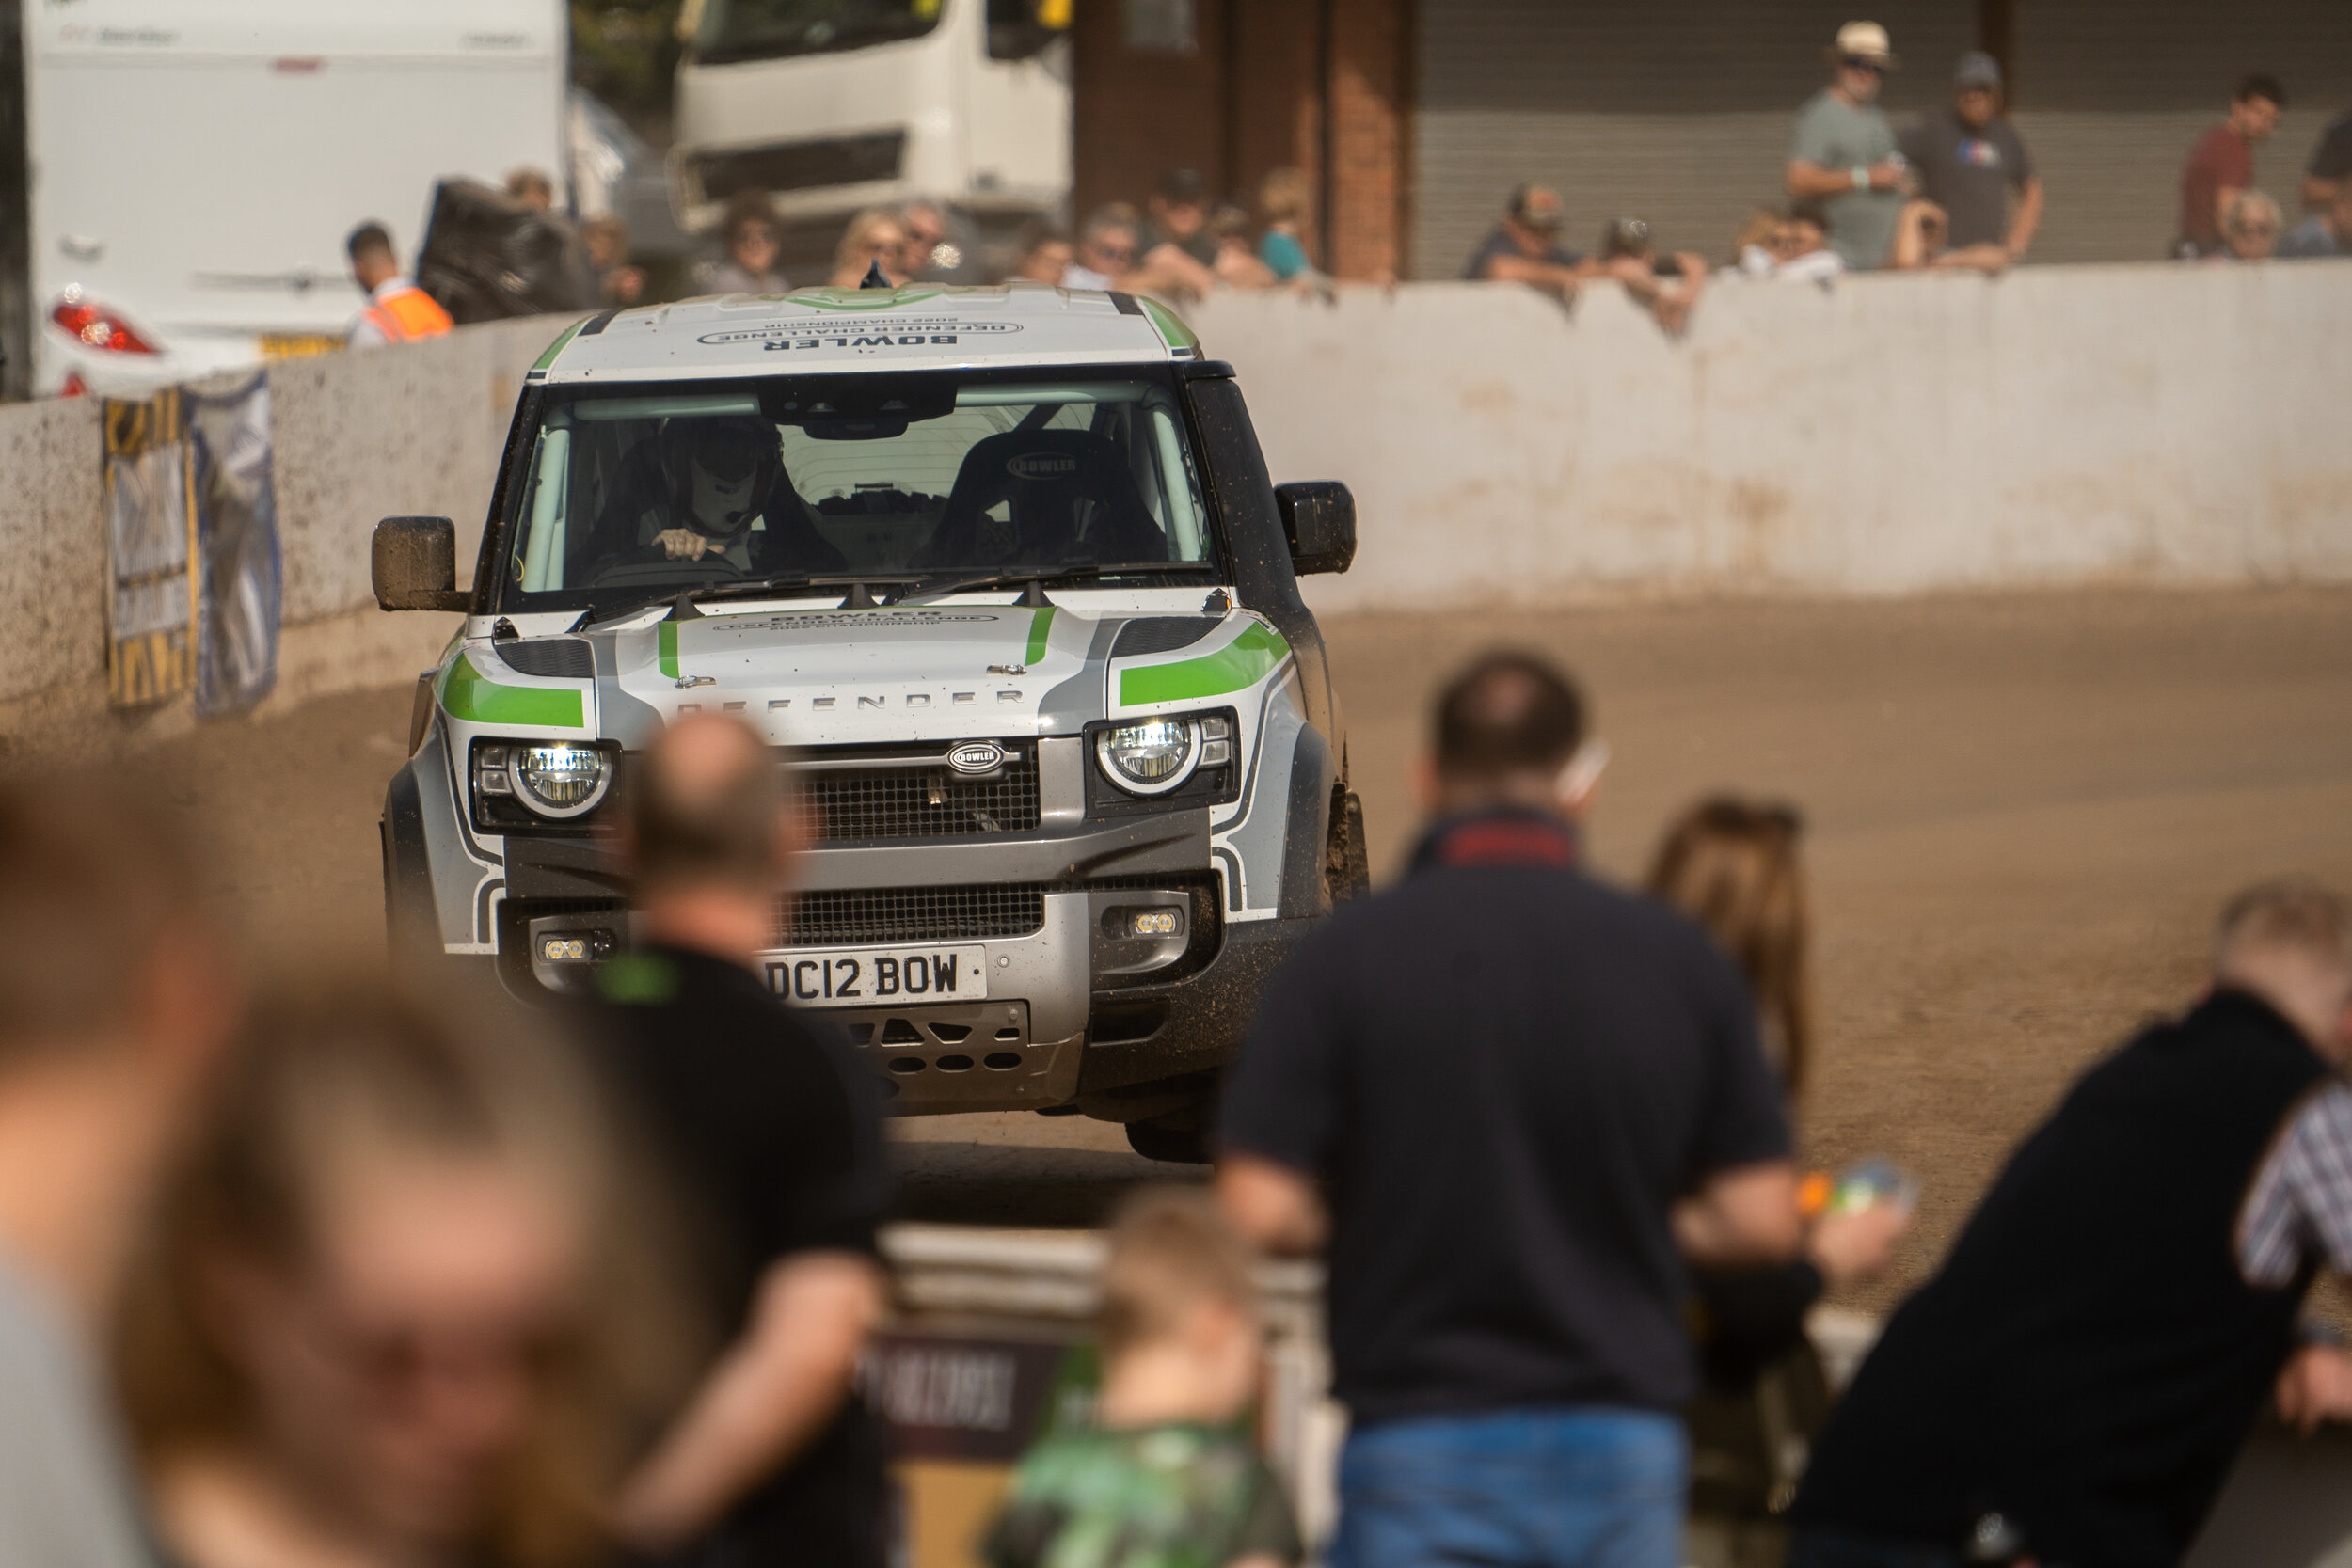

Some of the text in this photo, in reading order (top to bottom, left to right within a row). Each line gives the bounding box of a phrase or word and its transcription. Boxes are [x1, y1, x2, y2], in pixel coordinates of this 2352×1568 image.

[765, 319, 907, 329] CHAMPIONSHIP
[718, 325, 1006, 341] DEFENDER CHALLENGE
[764, 335, 958, 351] BOWLER
[1019, 459, 1076, 472] BOWLER
[771, 611, 942, 623] BOWLER
[677, 690, 1025, 717] DEFENDER
[961, 752, 995, 762] BOWLER
[765, 954, 958, 1001] DC12 BOW
